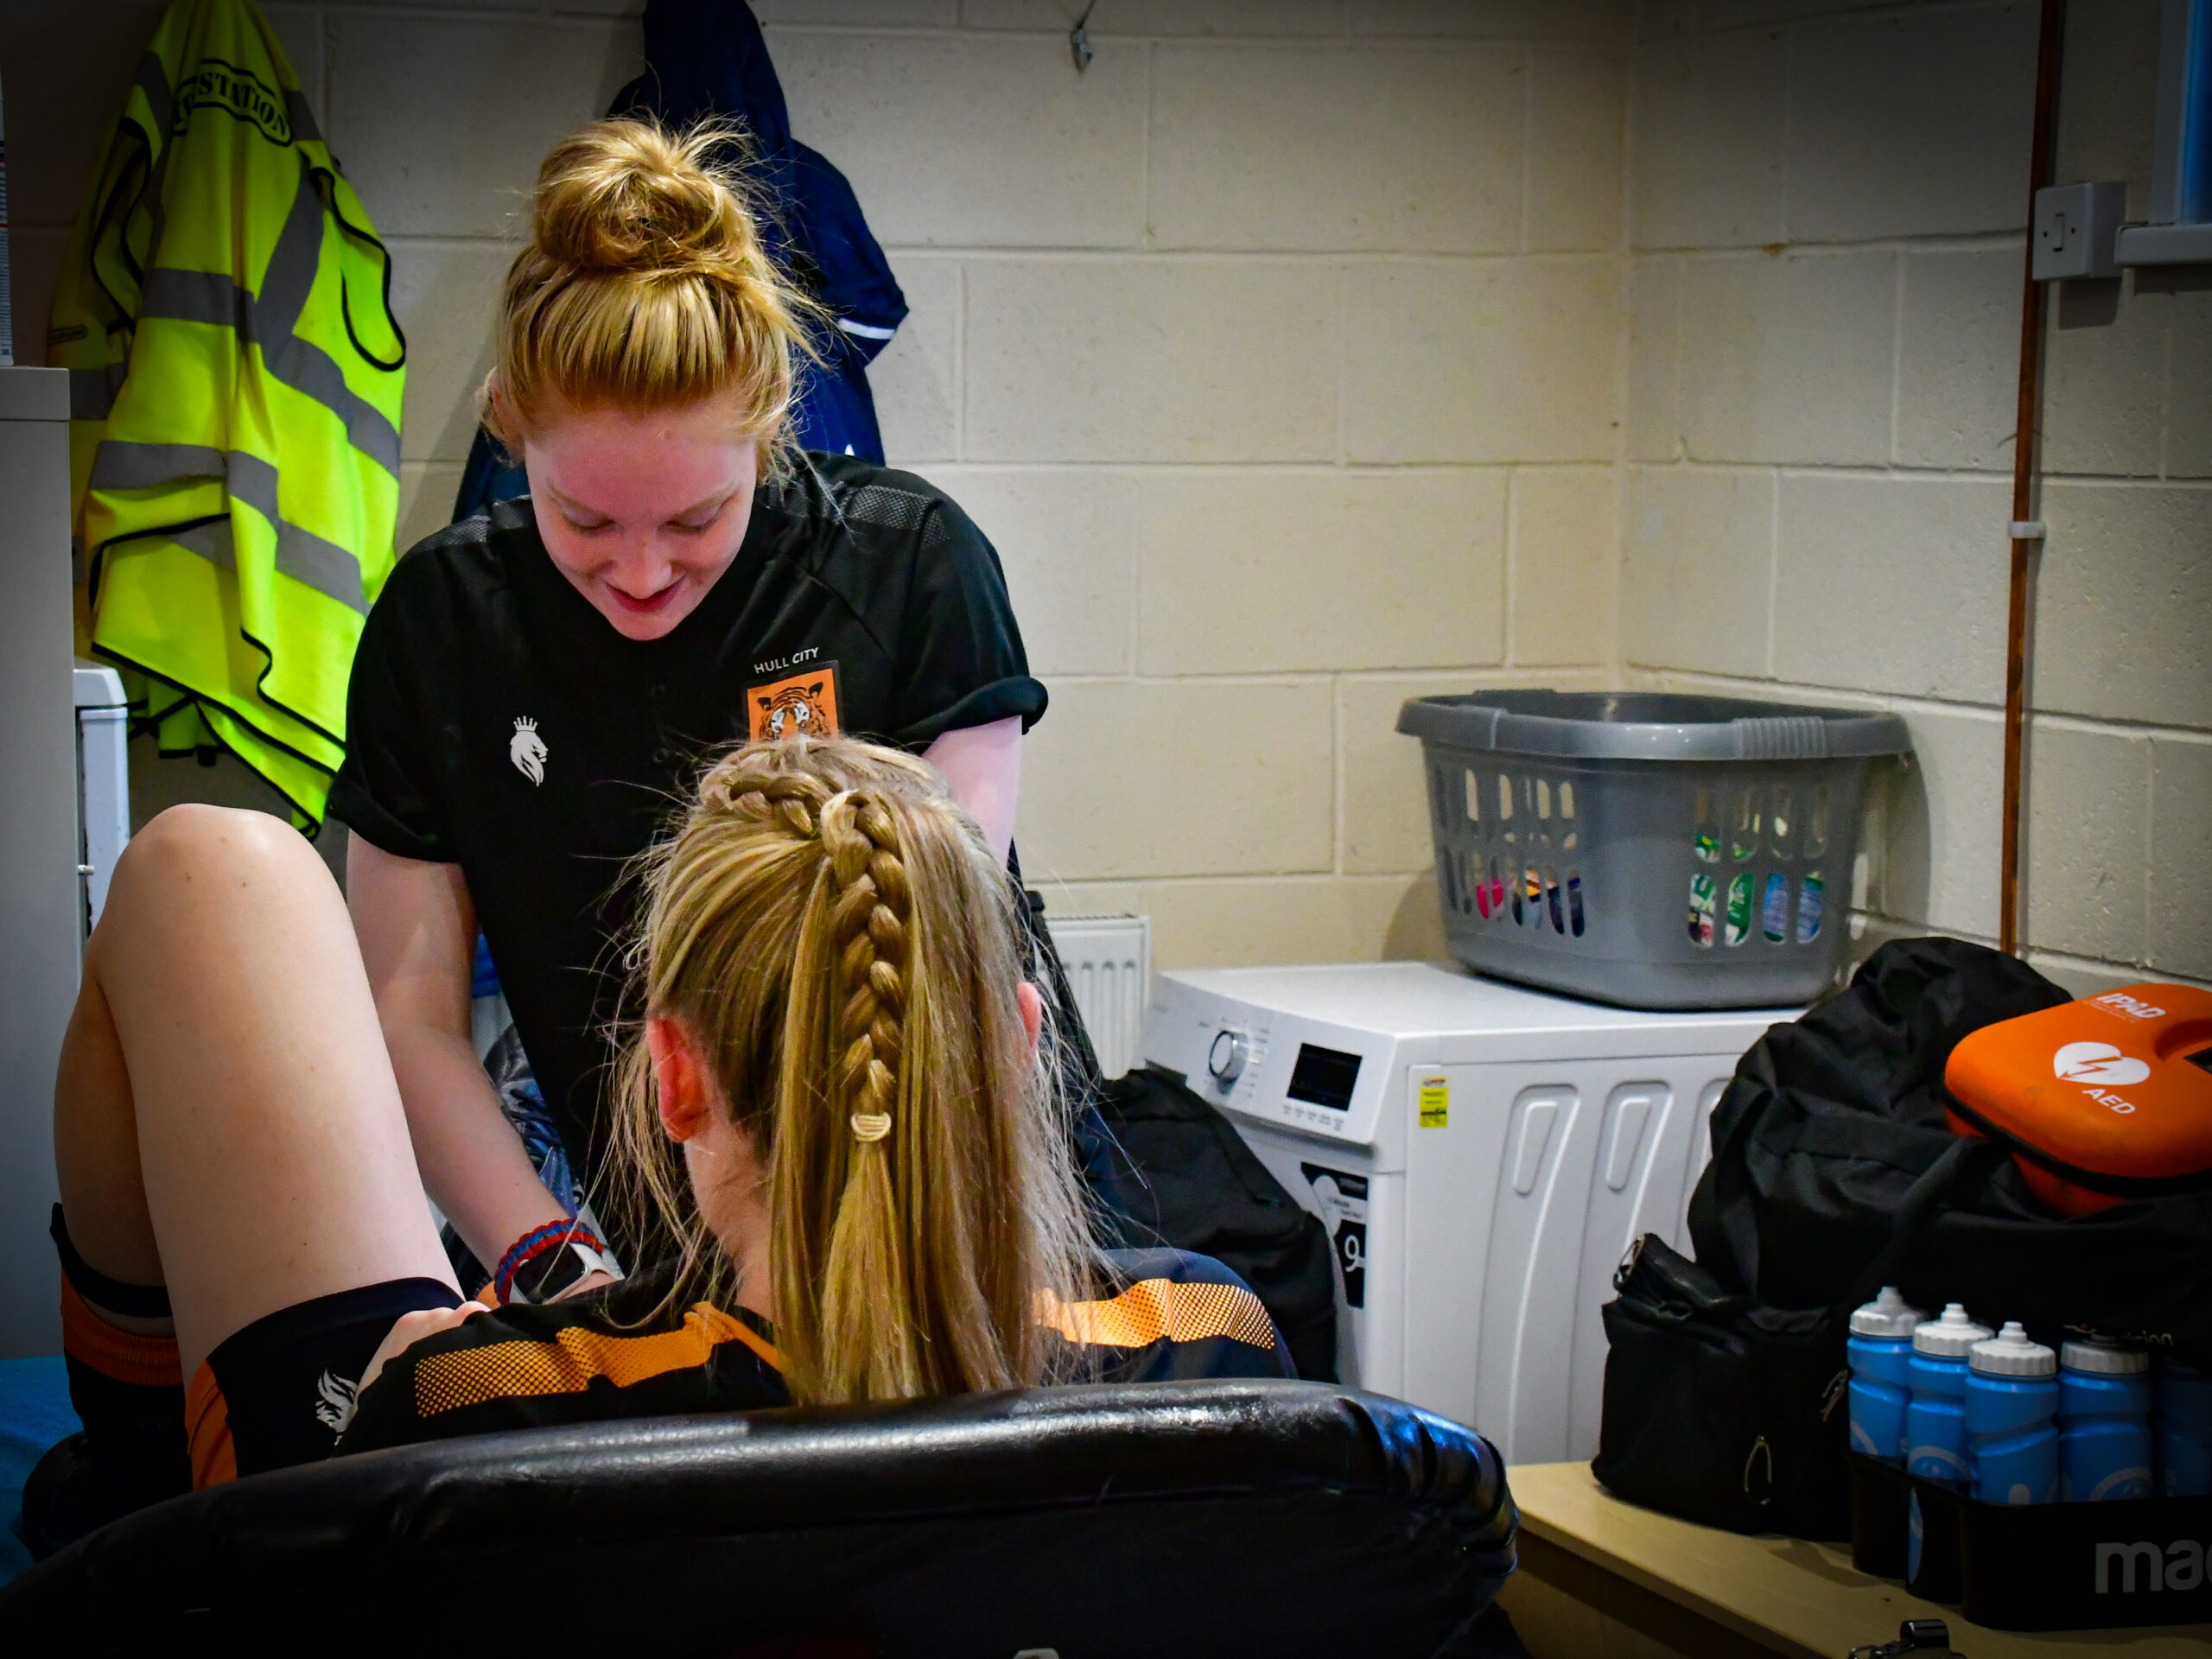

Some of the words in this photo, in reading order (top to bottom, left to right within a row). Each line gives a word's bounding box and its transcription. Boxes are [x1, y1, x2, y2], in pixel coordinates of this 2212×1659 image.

[753, 657, 790, 674] HULL
[791, 646, 819, 664] CITY
[2082, 1088, 2136, 1115] AED
[2094, 1539, 2212, 1594] ma
